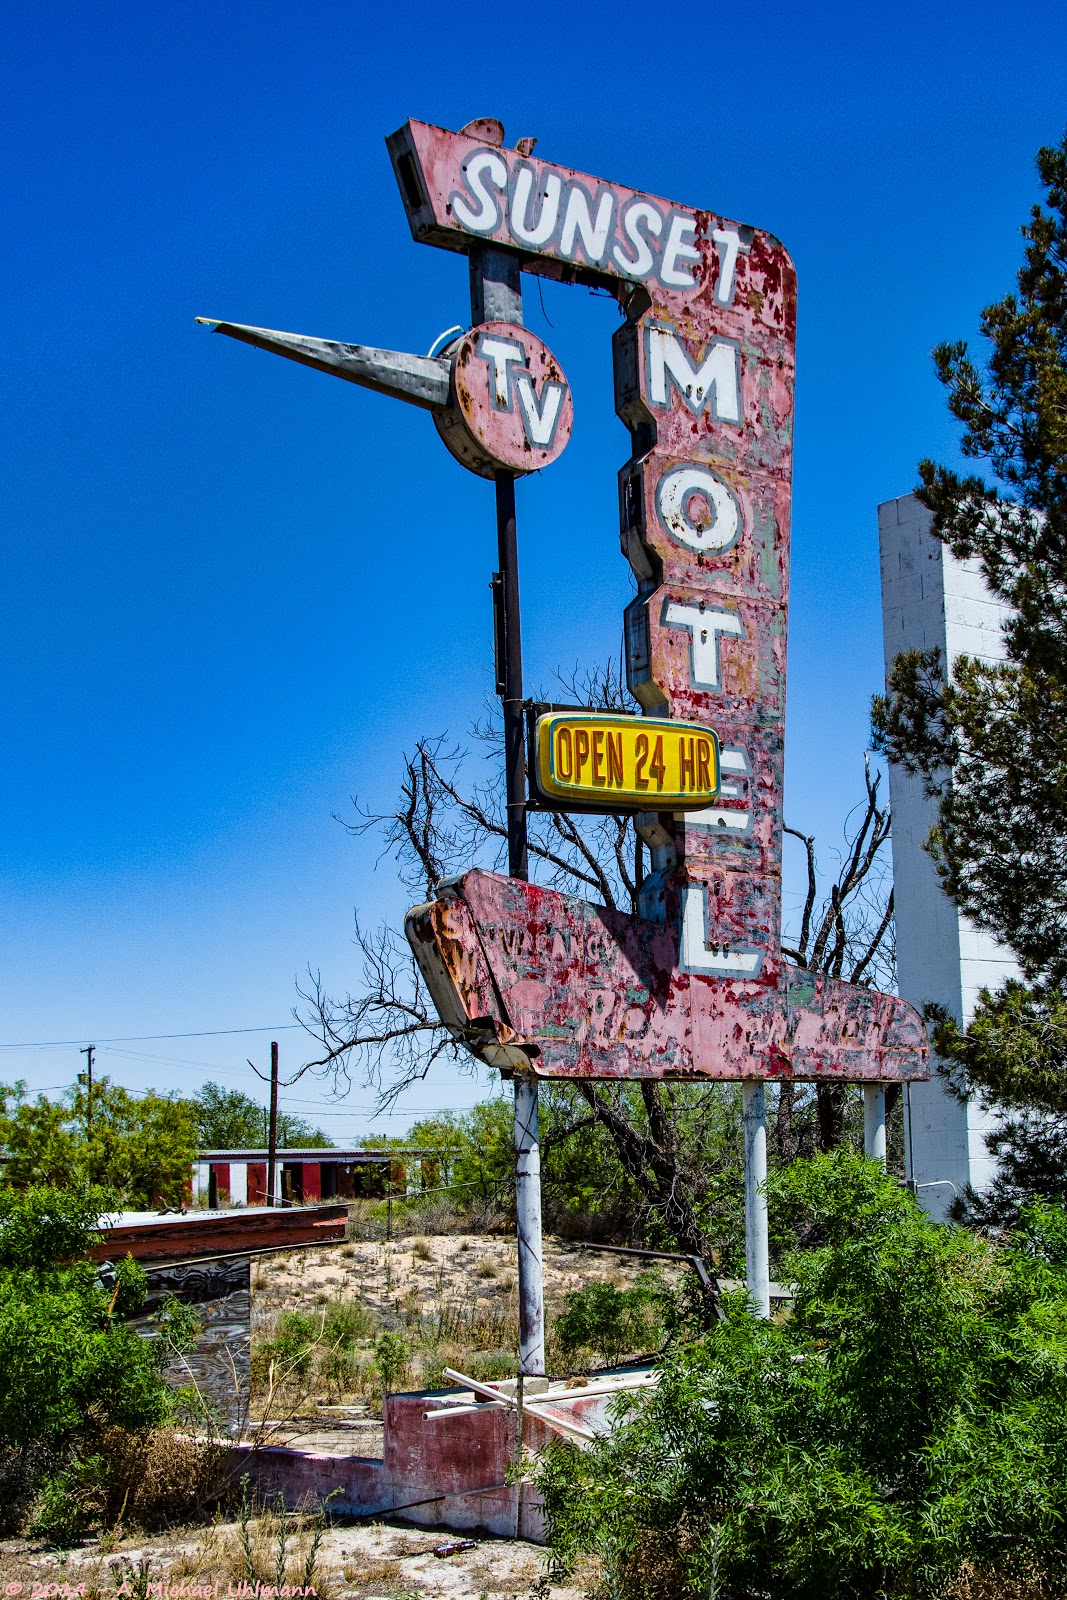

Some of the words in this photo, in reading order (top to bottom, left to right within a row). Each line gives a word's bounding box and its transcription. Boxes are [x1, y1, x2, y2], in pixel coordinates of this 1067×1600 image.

[453, 153, 749, 303] SUNSET
[481, 338, 562, 445] TV
[557, 727, 625, 783] OPEN
[636, 733, 666, 786] 24
[680, 736, 712, 789] HR
